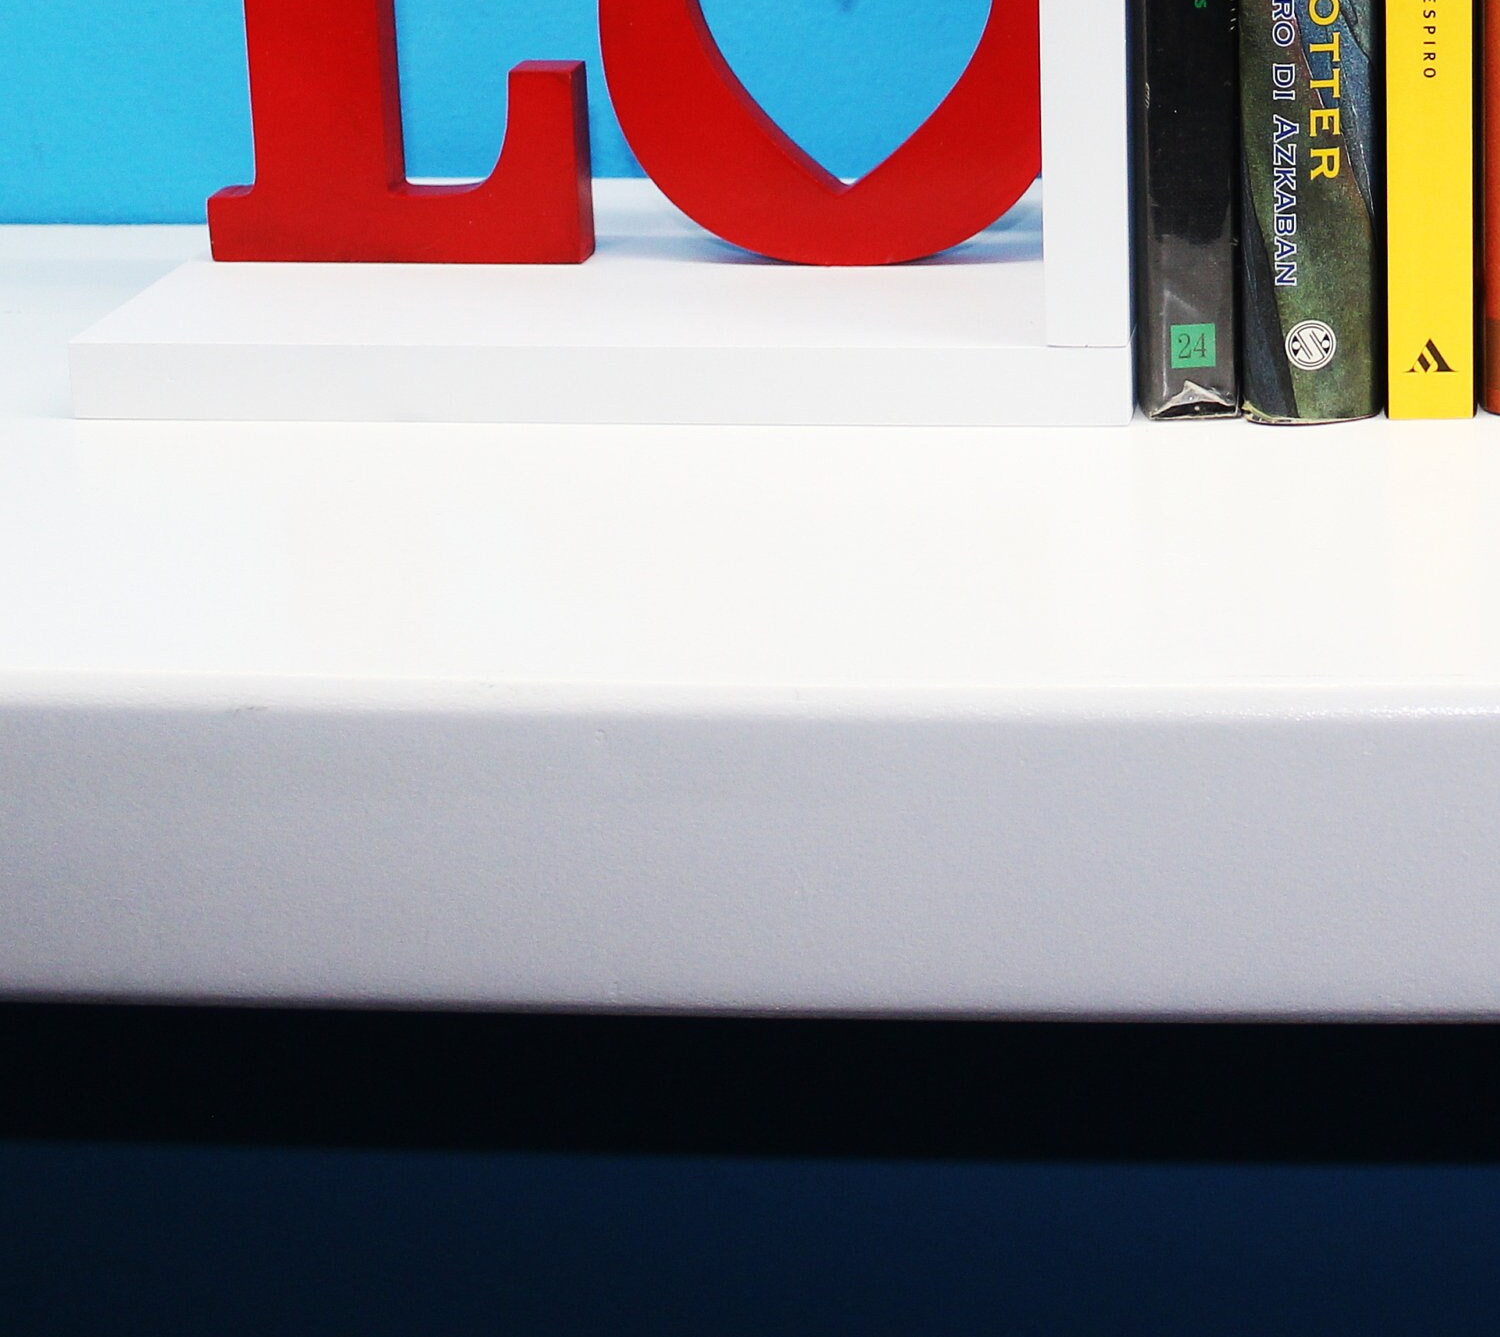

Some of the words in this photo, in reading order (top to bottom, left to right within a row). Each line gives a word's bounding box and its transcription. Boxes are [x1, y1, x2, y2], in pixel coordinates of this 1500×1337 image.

[1272, 63, 1296, 101] DI
[1273, 115, 1299, 287] AZKABAN
[1177, 333, 1207, 359] 24
